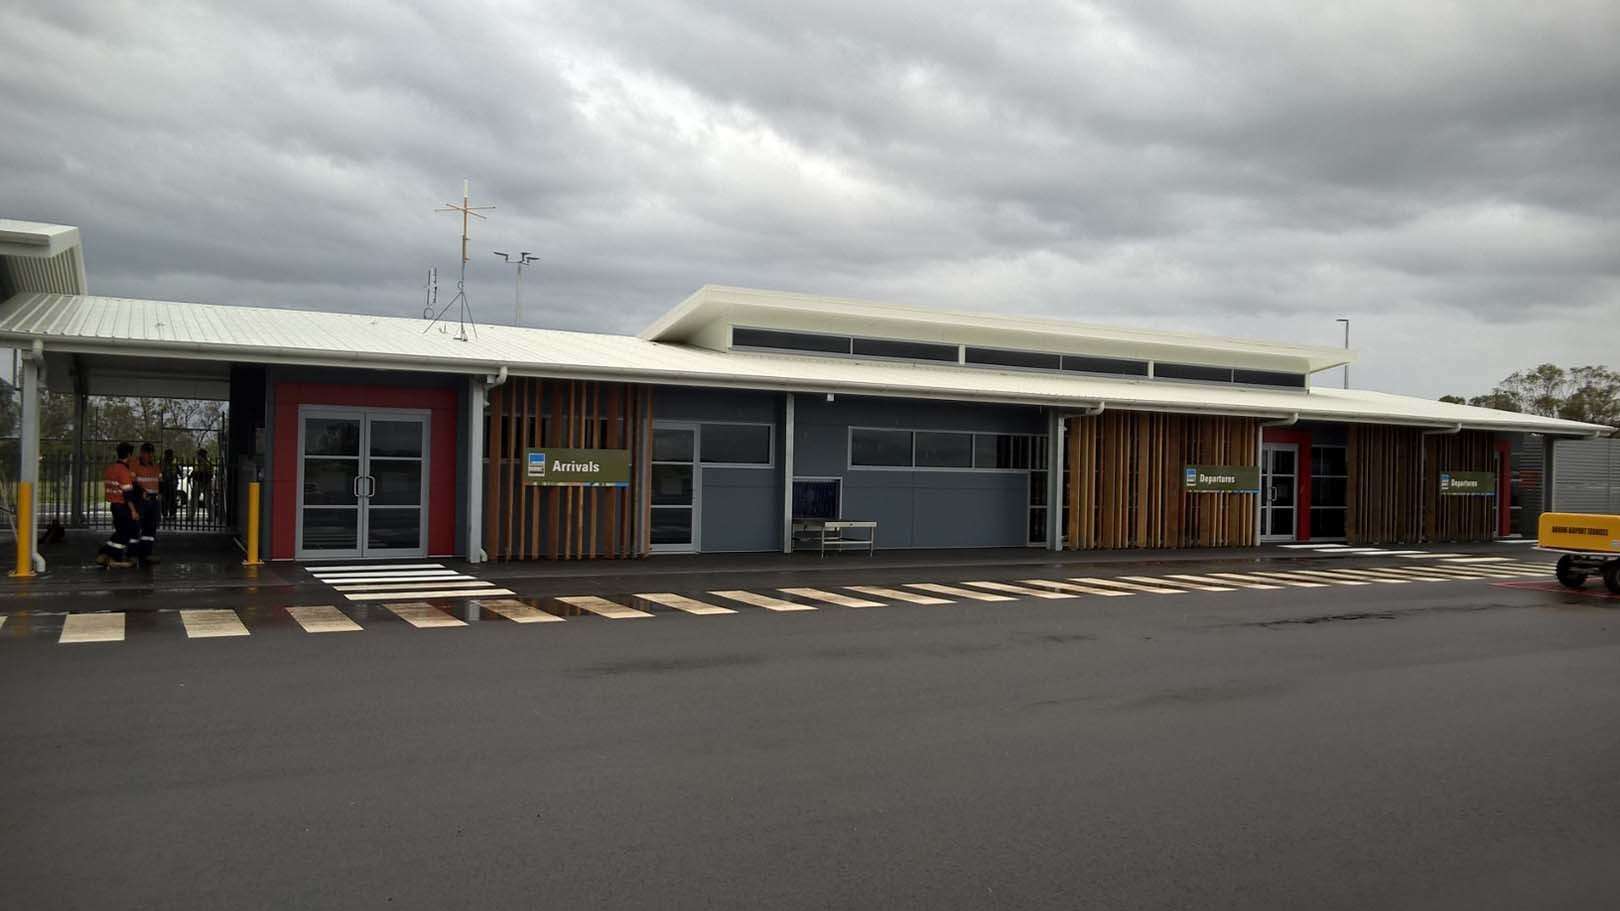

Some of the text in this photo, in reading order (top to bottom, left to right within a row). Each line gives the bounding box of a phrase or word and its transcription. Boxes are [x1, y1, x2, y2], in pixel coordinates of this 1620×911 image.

[552, 460, 600, 472] Arrivals
[1199, 474, 1235, 485] Departures
[1451, 478, 1478, 488] Departures
